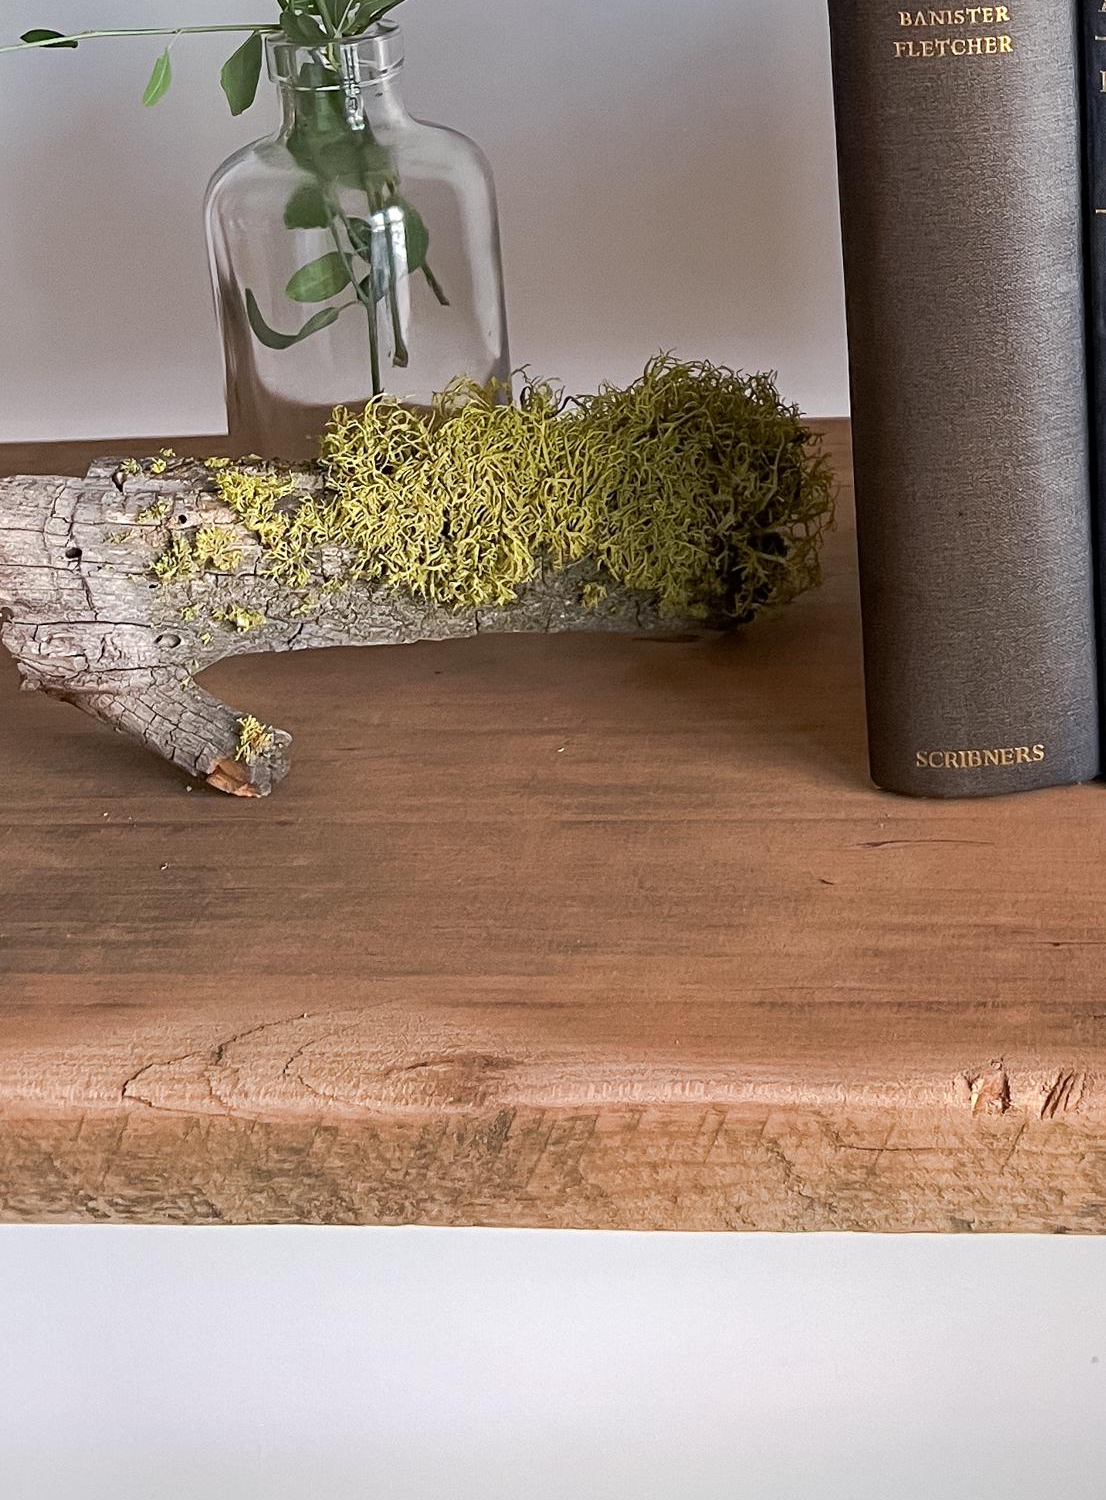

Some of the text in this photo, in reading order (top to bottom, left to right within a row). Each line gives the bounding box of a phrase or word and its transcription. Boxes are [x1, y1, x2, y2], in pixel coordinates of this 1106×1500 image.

[898, 5, 1010, 27] BANISTER
[893, 35, 1013, 58] FLETCHER
[916, 744, 1045, 768] SCRIBNERS
